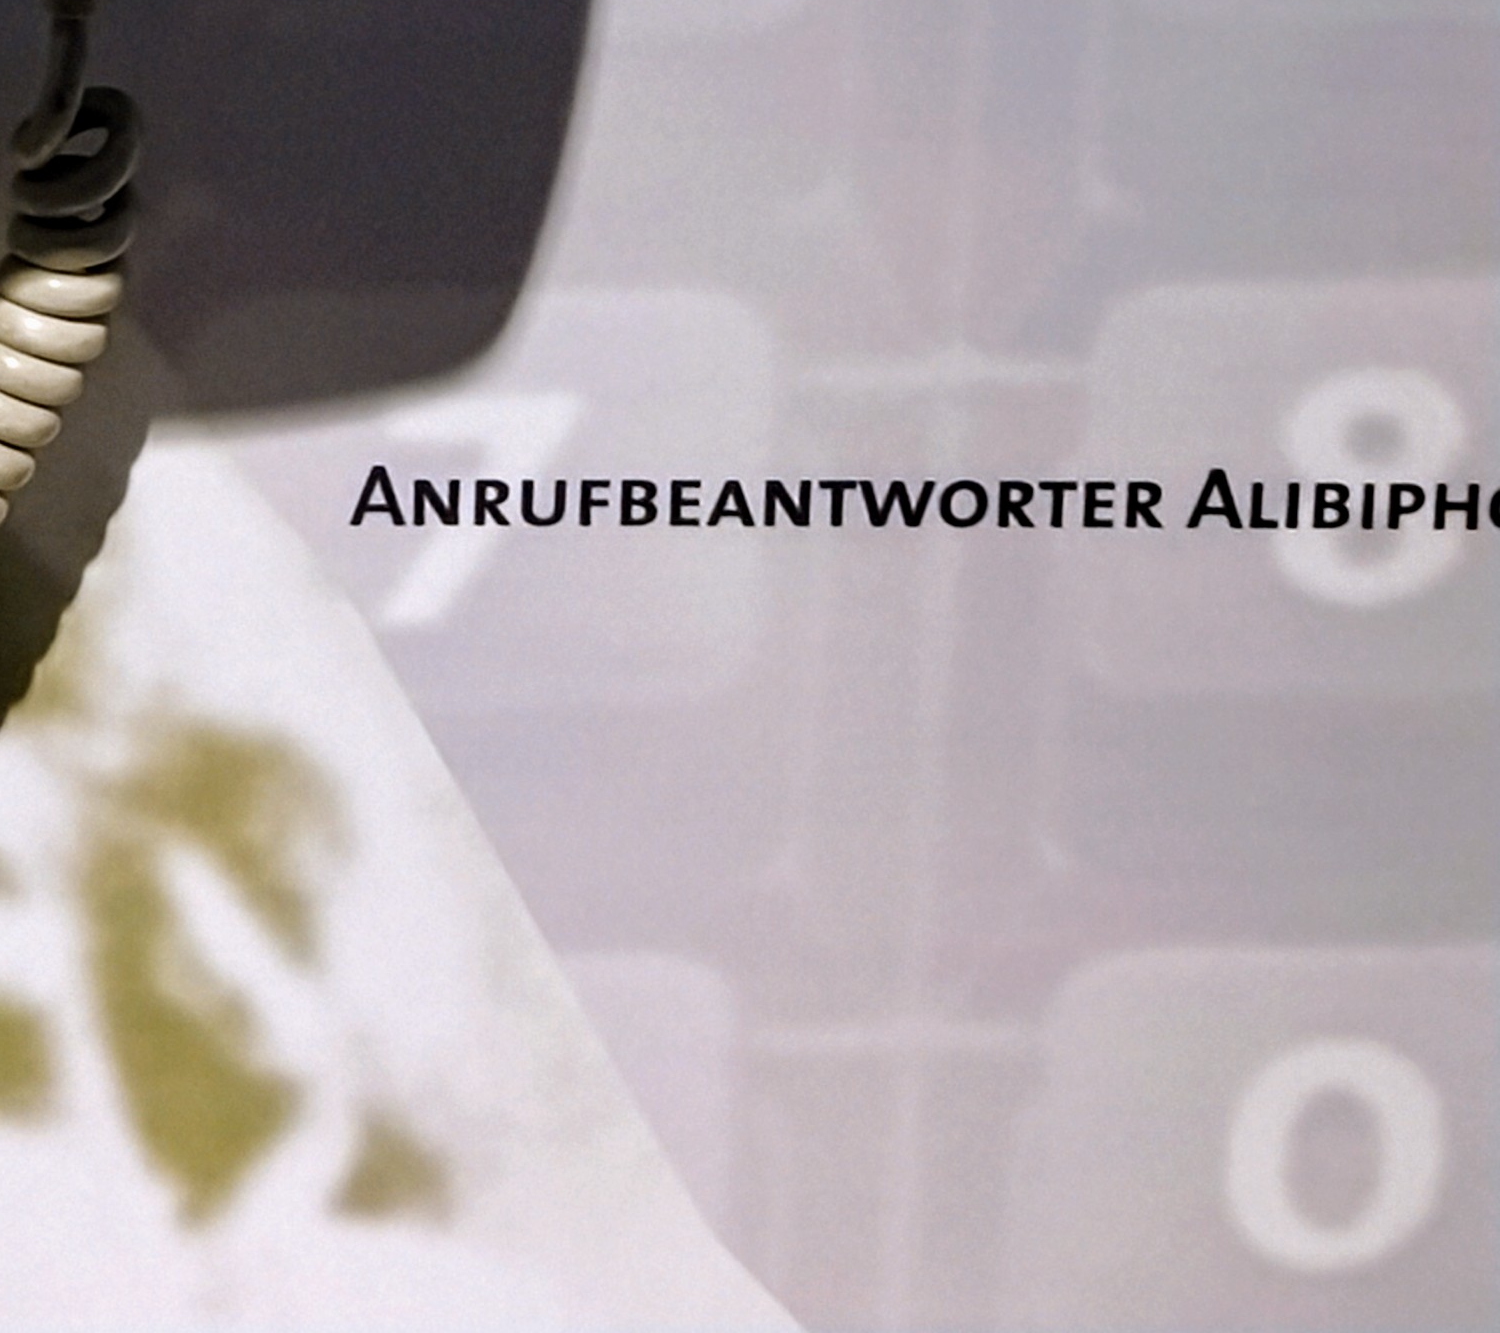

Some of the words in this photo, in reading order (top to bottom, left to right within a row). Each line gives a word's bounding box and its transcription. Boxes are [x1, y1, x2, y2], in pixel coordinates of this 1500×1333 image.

[380, 390, 587, 630] 7
[1186, 468, 1500, 531] ALIBIPH
[1275, 366, 1464, 606] 8
